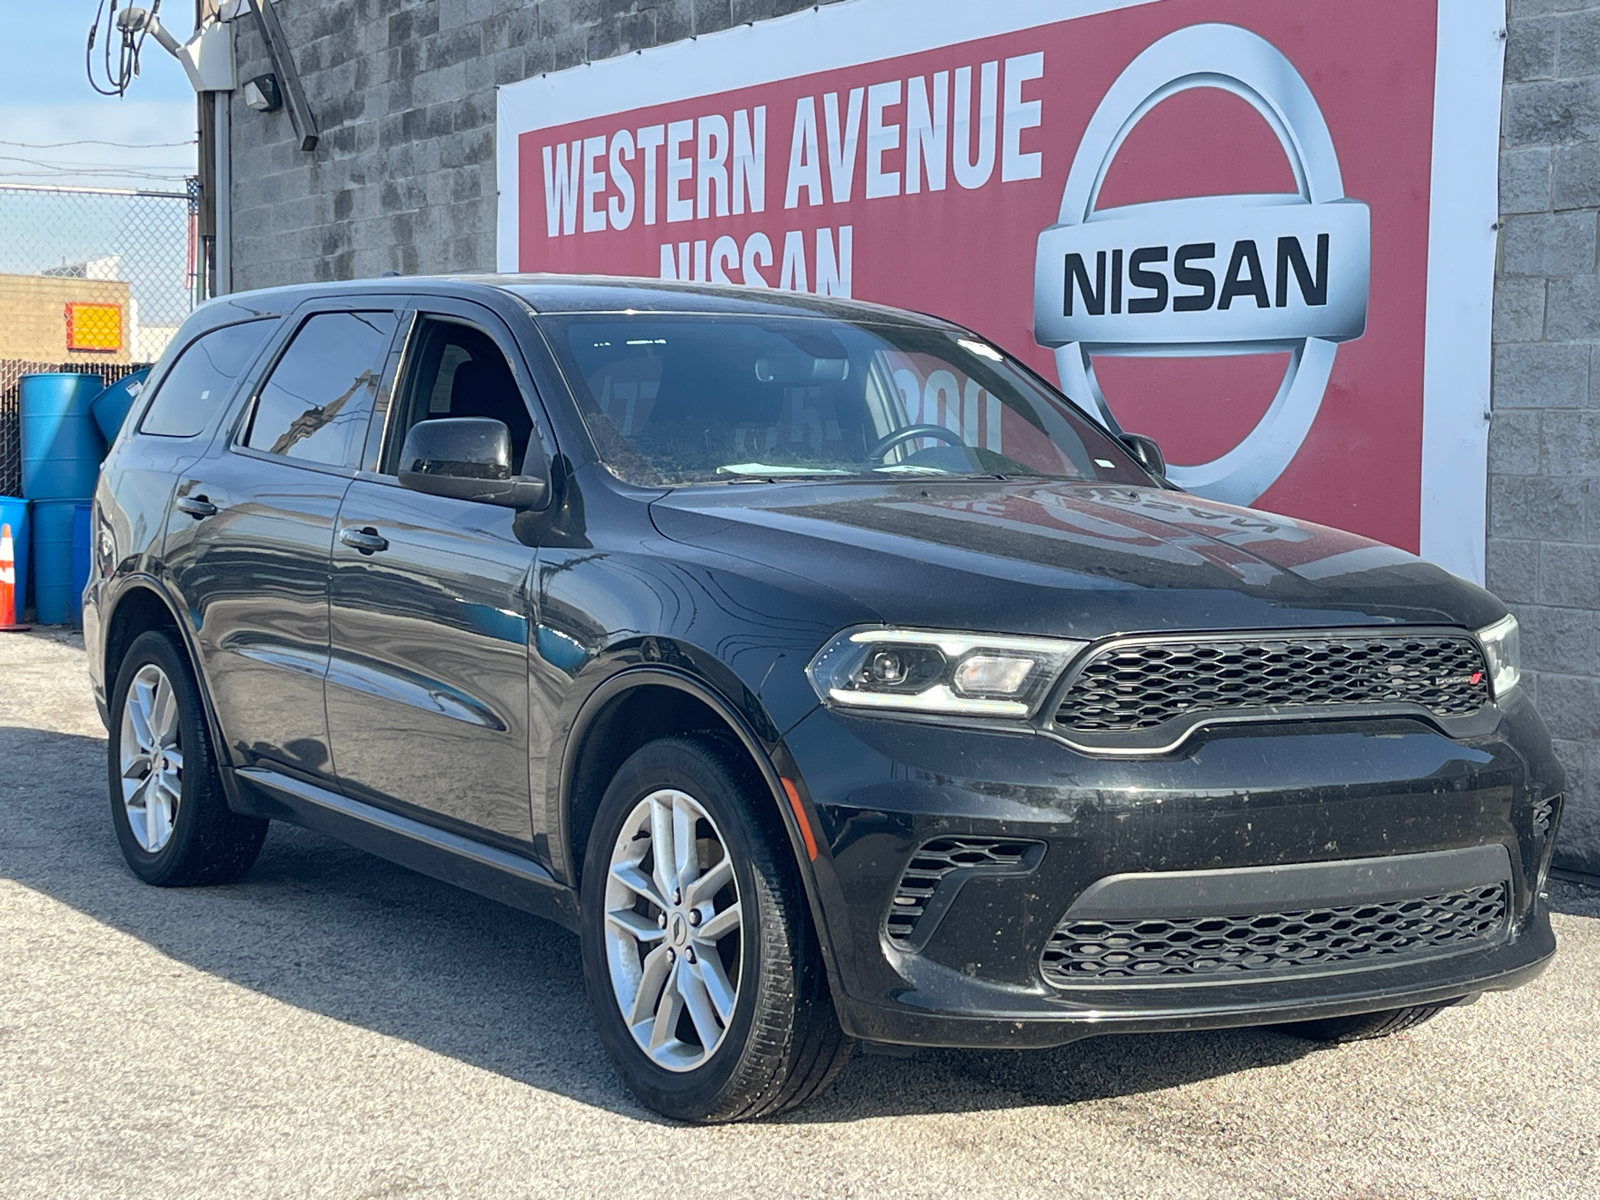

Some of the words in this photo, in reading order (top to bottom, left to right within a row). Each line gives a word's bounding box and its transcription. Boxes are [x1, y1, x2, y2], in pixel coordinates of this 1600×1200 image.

[542, 105, 766, 237] WESTERN
[784, 51, 1044, 210] AVENUE
[1063, 233, 1330, 317] NISSAN
